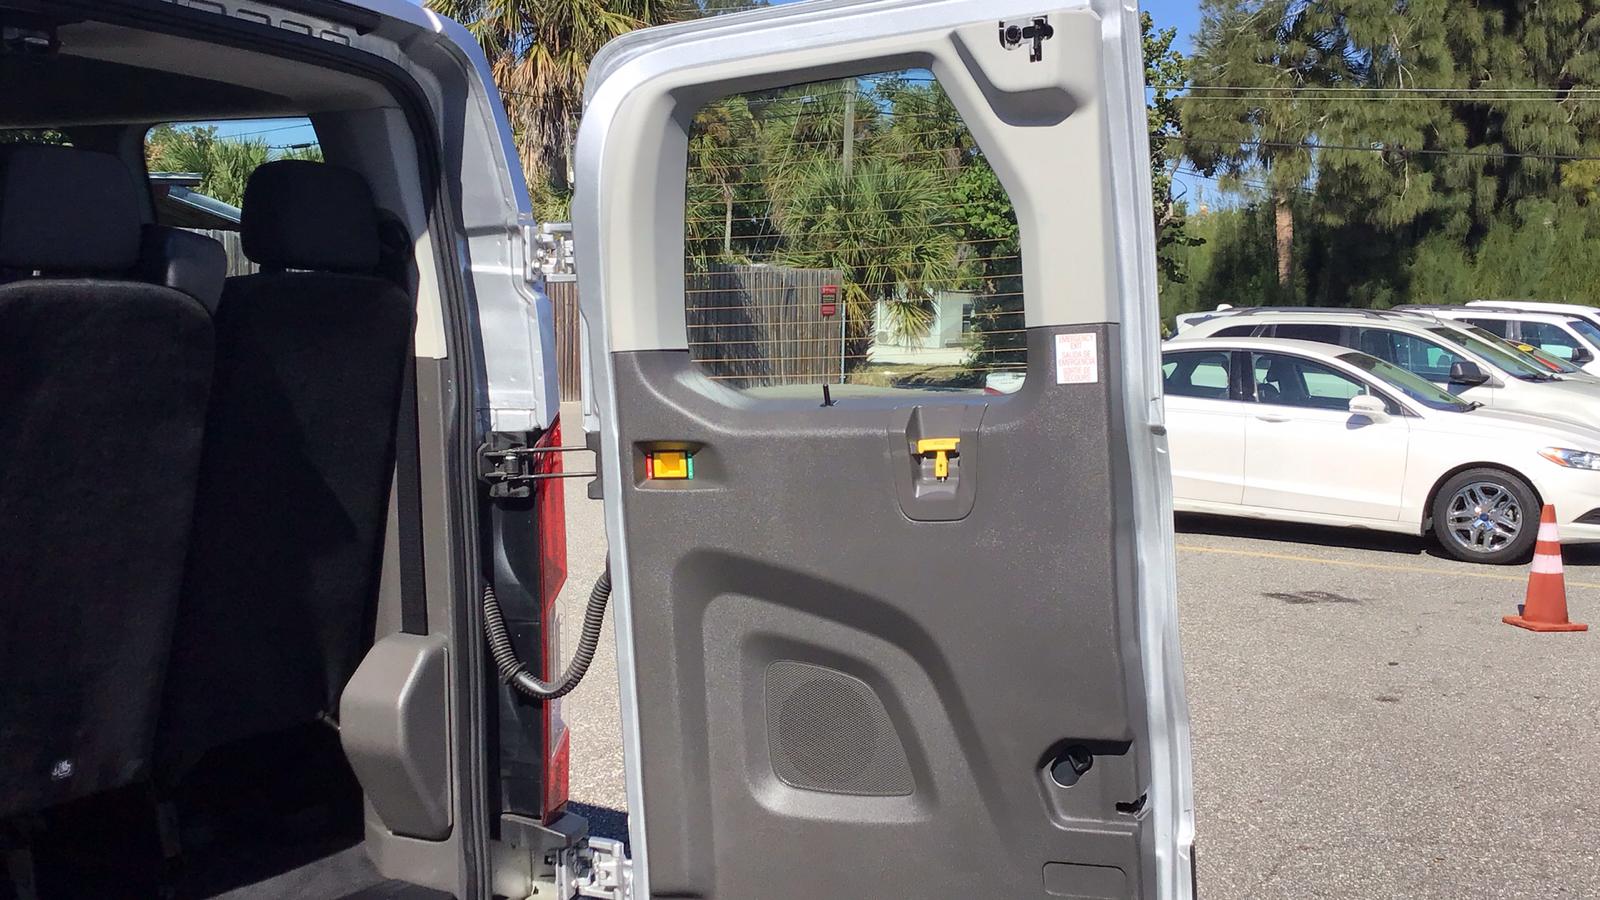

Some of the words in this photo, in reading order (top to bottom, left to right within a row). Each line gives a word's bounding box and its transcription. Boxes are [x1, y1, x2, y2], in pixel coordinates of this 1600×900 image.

[1059, 335, 1093, 343] EMERGENCY
[1061, 350, 1082, 358] SALIDA
[1058, 357, 1095, 366] EMERGENCIA
[1062, 366, 1082, 374] SORTIE
